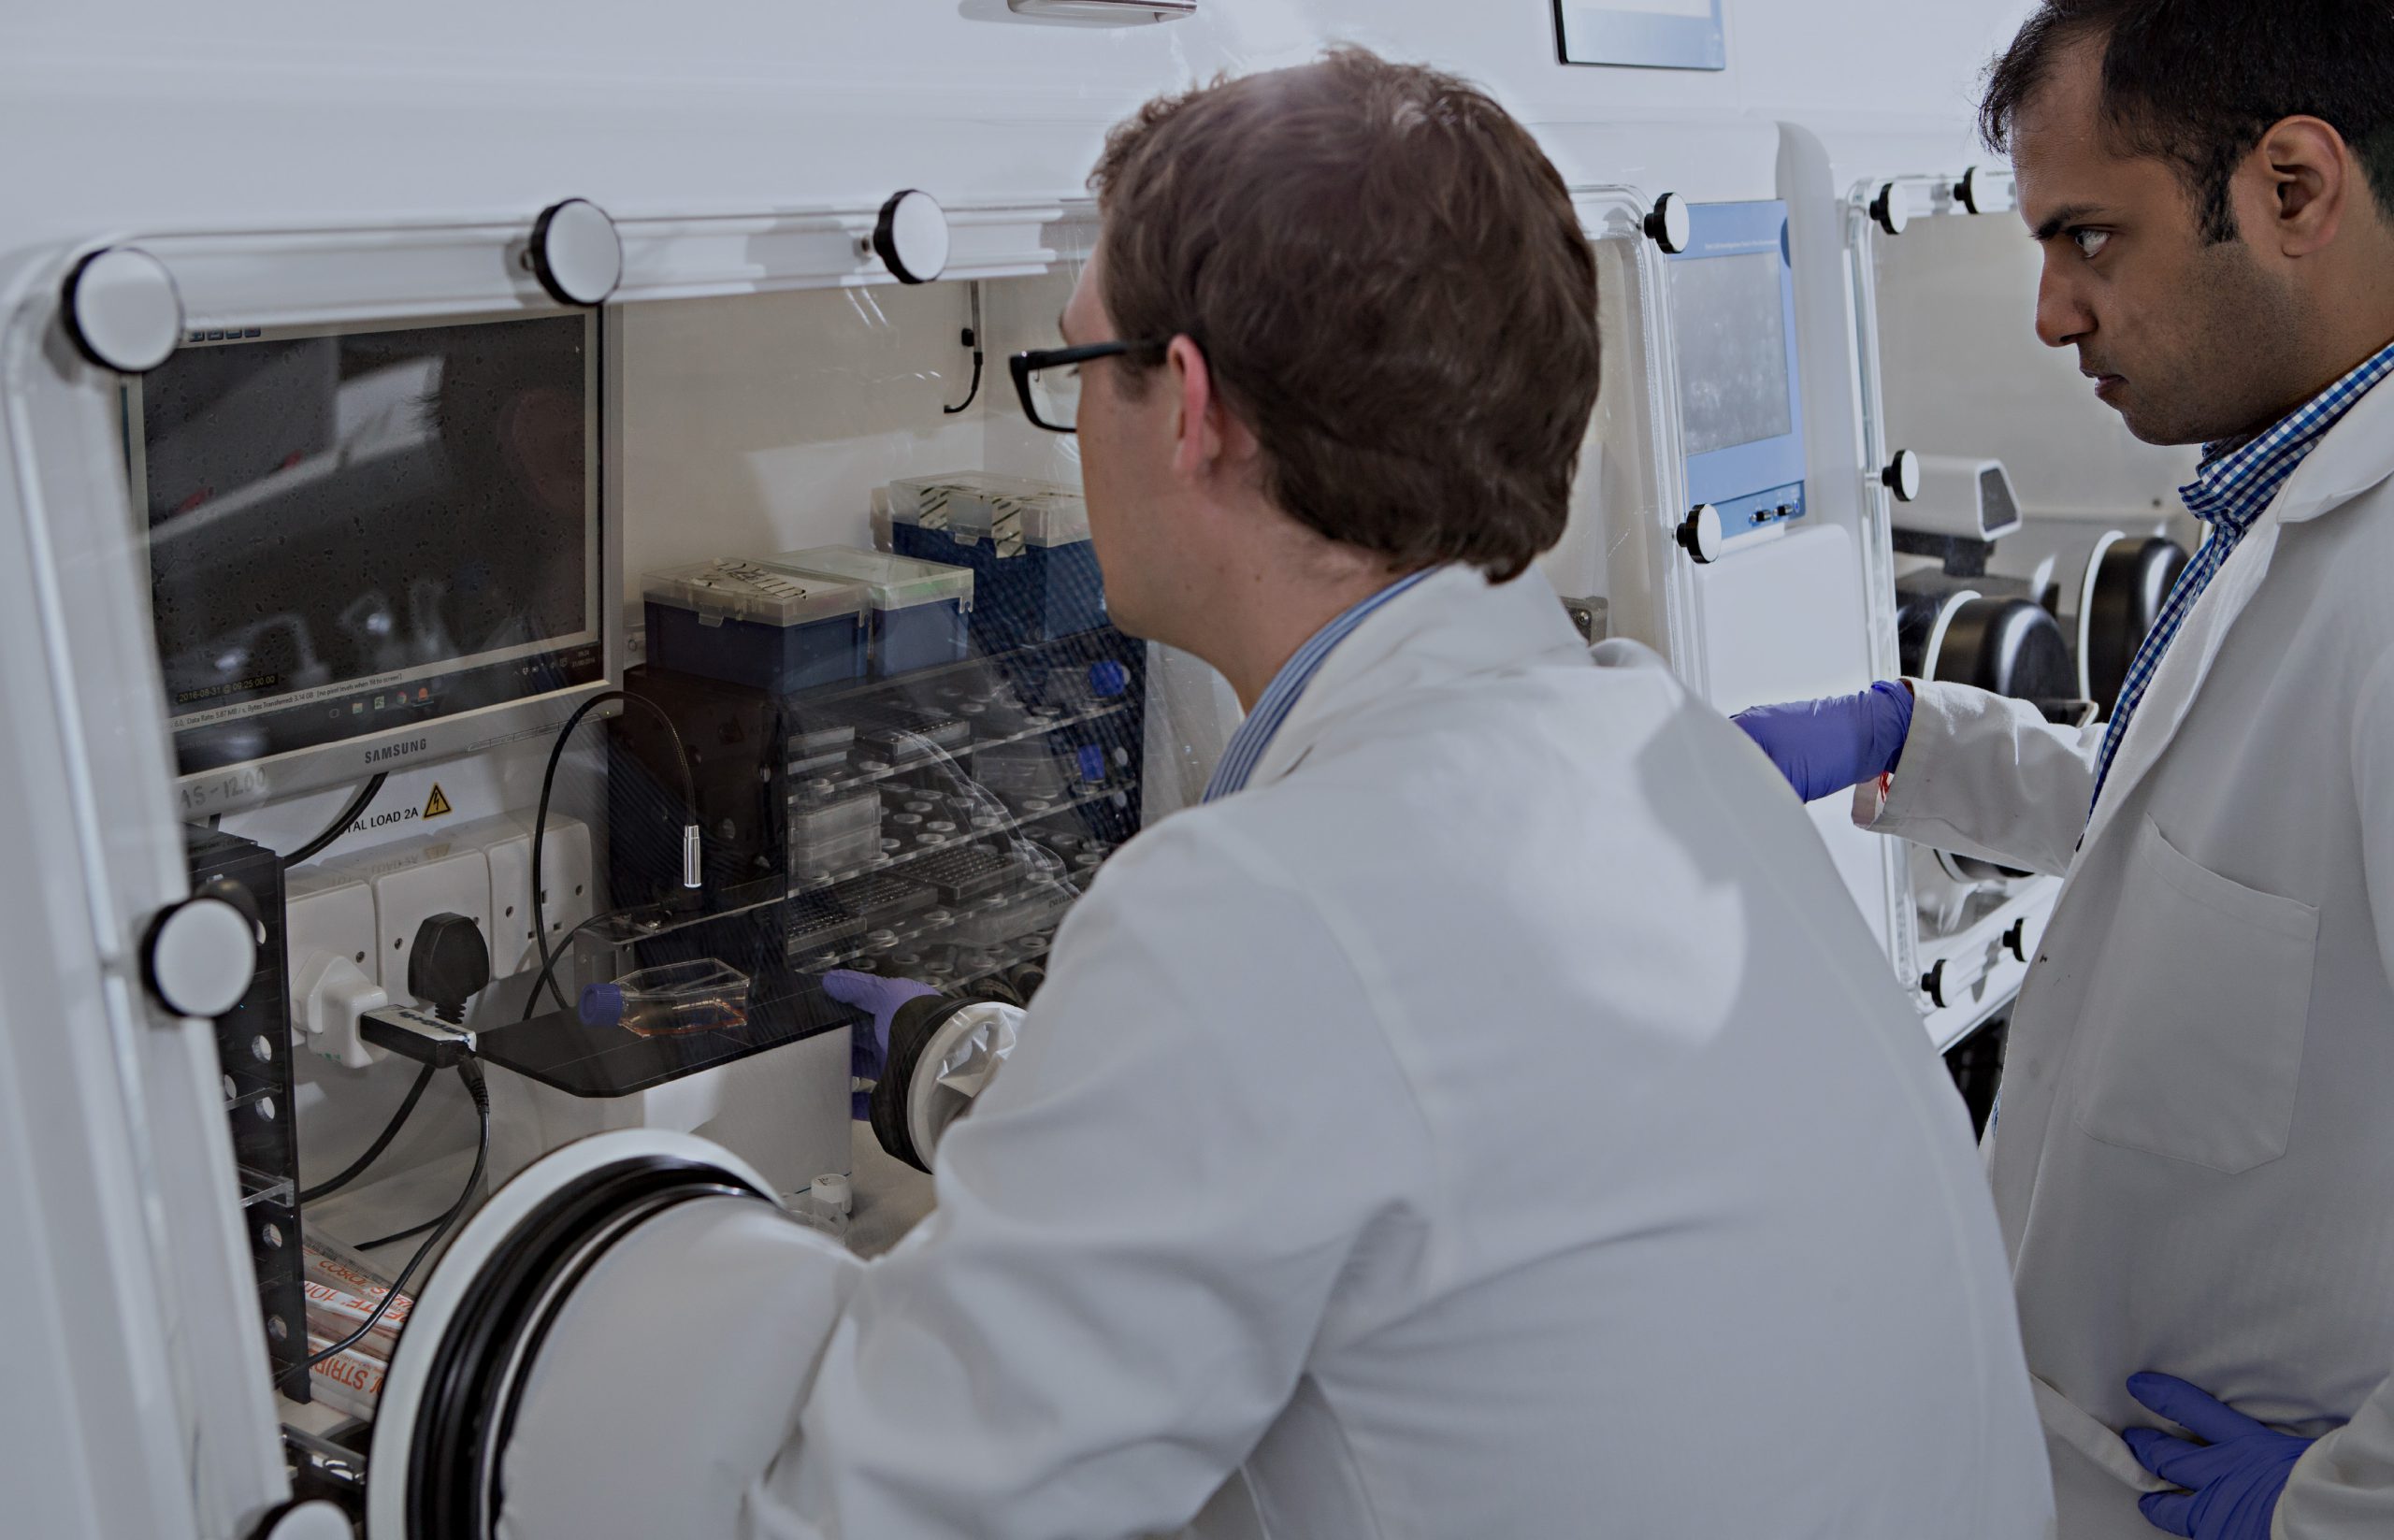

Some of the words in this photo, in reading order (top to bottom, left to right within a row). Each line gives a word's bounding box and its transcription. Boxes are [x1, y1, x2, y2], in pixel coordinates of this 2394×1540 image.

[187, 716, 200, 726] Data
[247, 703, 262, 713] Bytes
[339, 684, 353, 693] levels
[354, 681, 368, 690] when
[364, 739, 426, 764] SAMSUNG
[370, 811, 401, 828] LOAD
[404, 807, 419, 820] 2A
